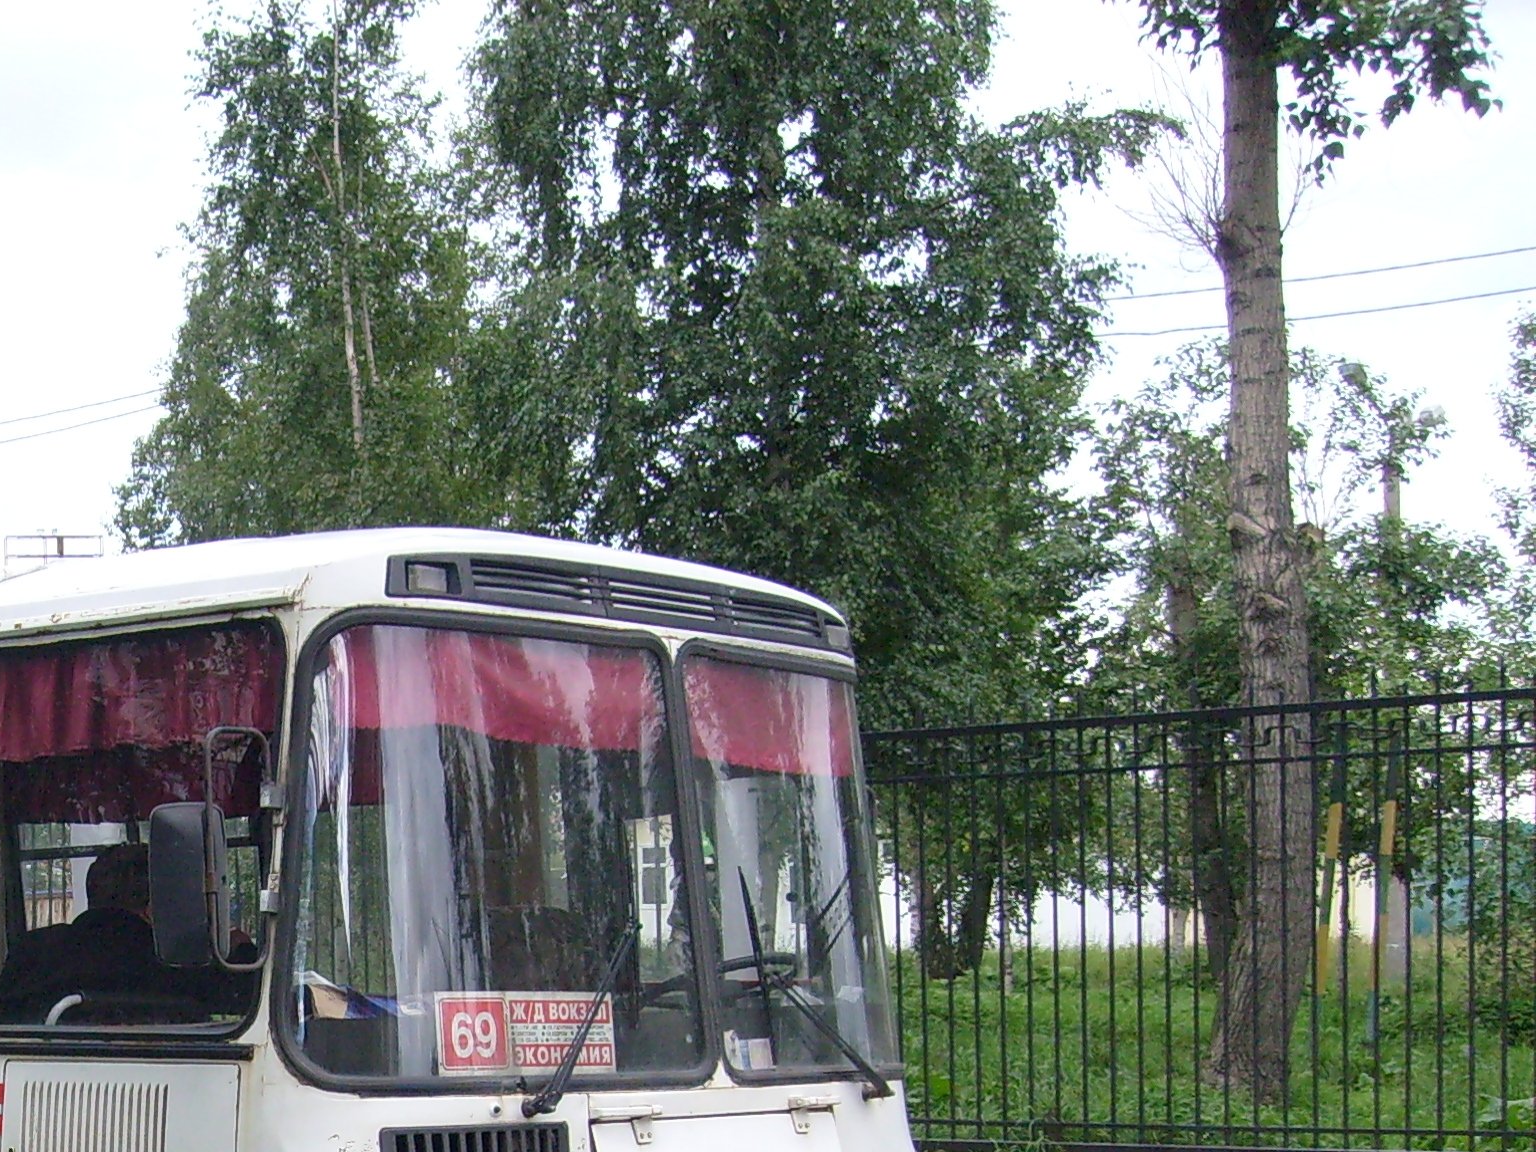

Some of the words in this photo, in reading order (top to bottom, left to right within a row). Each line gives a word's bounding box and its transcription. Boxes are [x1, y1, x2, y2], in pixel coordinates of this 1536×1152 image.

[512, 1001, 545, 1023] Ж/Д
[549, 1002, 607, 1021] ВОКЗЛ
[451, 1012, 498, 1059] 69
[515, 1046, 611, 1066] ЭКОНМИЯ
